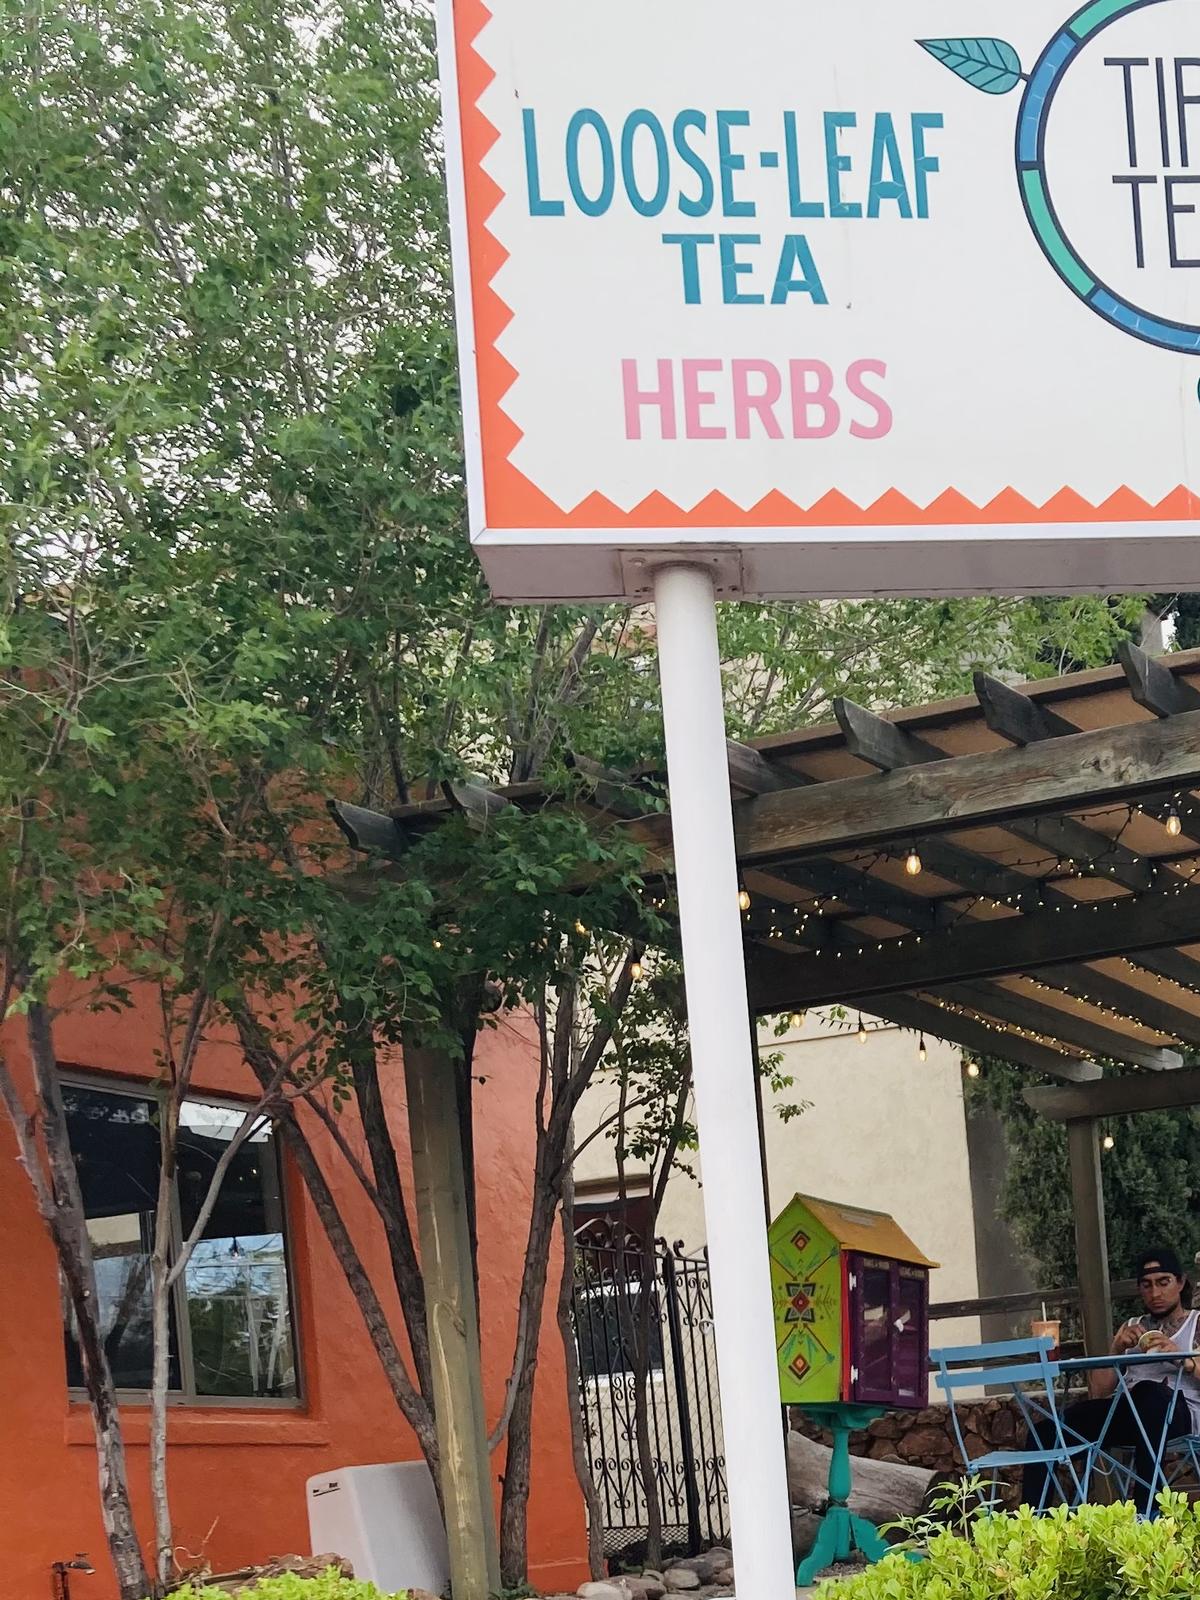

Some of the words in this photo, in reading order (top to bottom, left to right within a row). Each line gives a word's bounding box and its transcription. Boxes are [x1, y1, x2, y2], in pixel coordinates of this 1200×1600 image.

[522, 108, 945, 219] LOOSE-LEAF
[662, 234, 829, 305] TEA
[621, 358, 893, 440] HERBS
